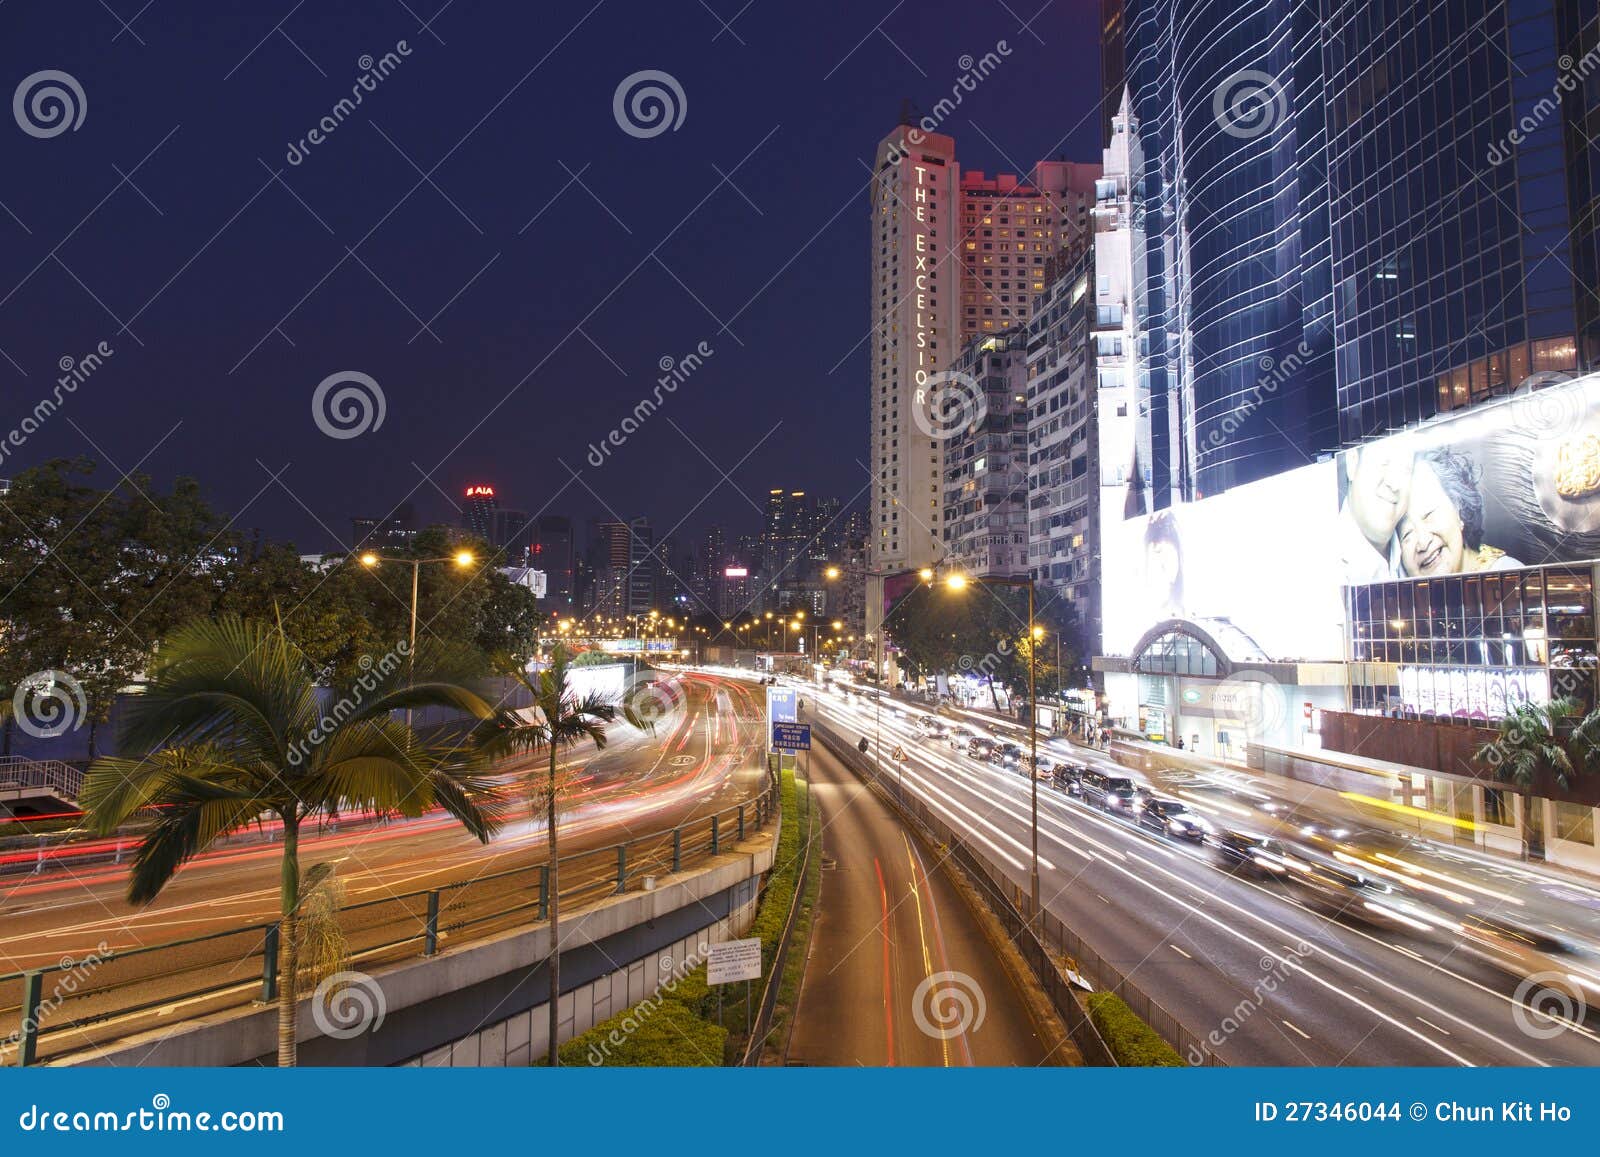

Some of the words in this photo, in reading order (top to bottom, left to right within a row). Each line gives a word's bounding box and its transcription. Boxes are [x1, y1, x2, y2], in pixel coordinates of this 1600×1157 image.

[915, 167, 926, 222] THE
[915, 234, 927, 404] EXCELSIOR
[475, 486, 494, 496] AIA
